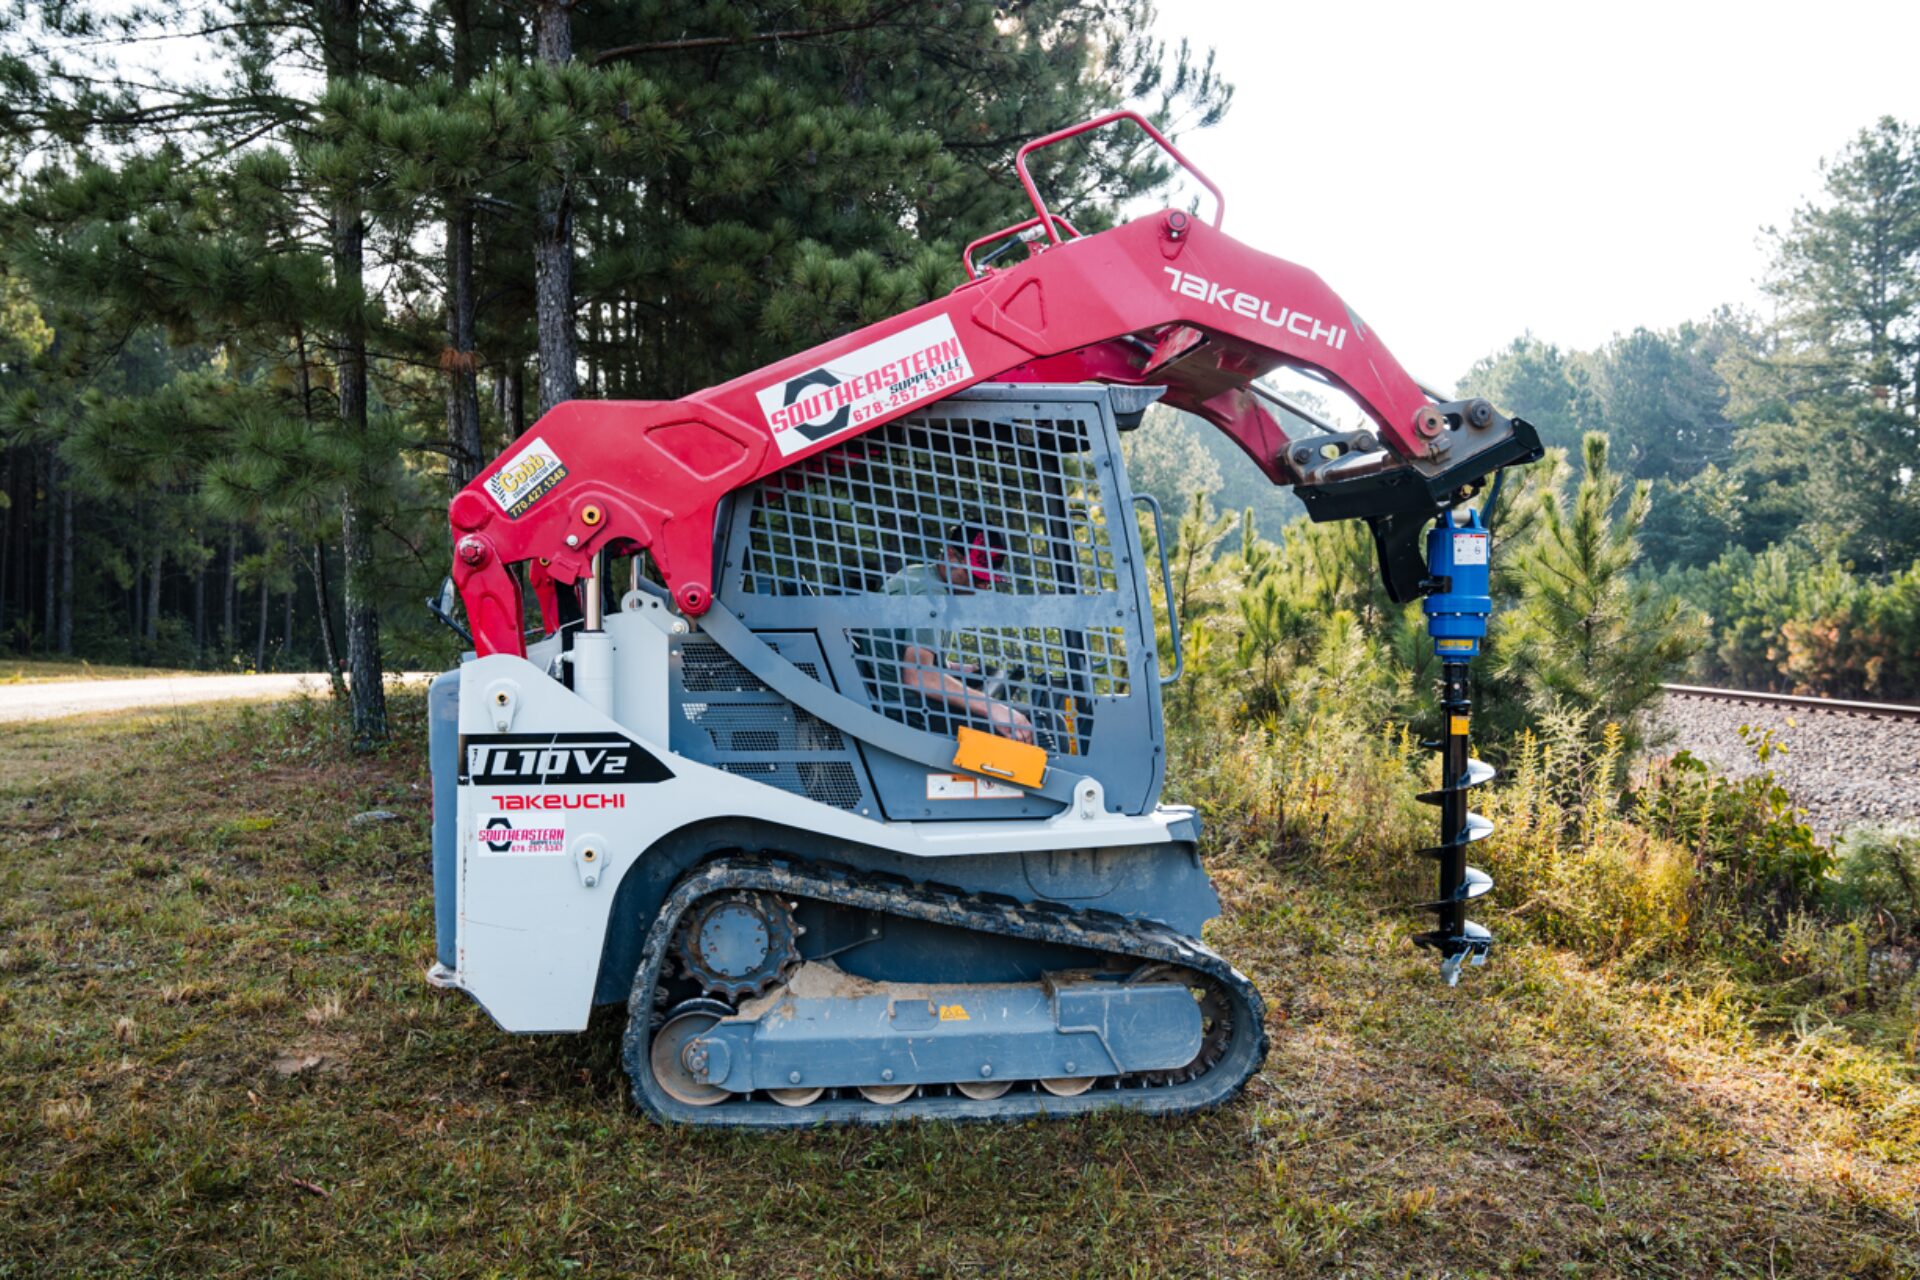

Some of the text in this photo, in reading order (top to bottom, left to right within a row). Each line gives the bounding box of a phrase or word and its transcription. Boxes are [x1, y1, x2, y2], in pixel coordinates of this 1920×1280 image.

[1163, 266, 1346, 350] TAKEUCHI
[770, 337, 961, 434] SOUTHEASTERN
[852, 367, 965, 423] 678-257-5347
[889, 356, 962, 394] SUPPLY LLC
[499, 454, 545, 493] Cobb
[510, 468, 566, 517] 770.427.1348
[491, 794, 625, 810] TAKEUCHI
[478, 828, 565, 842] SOUTHEASTERN
